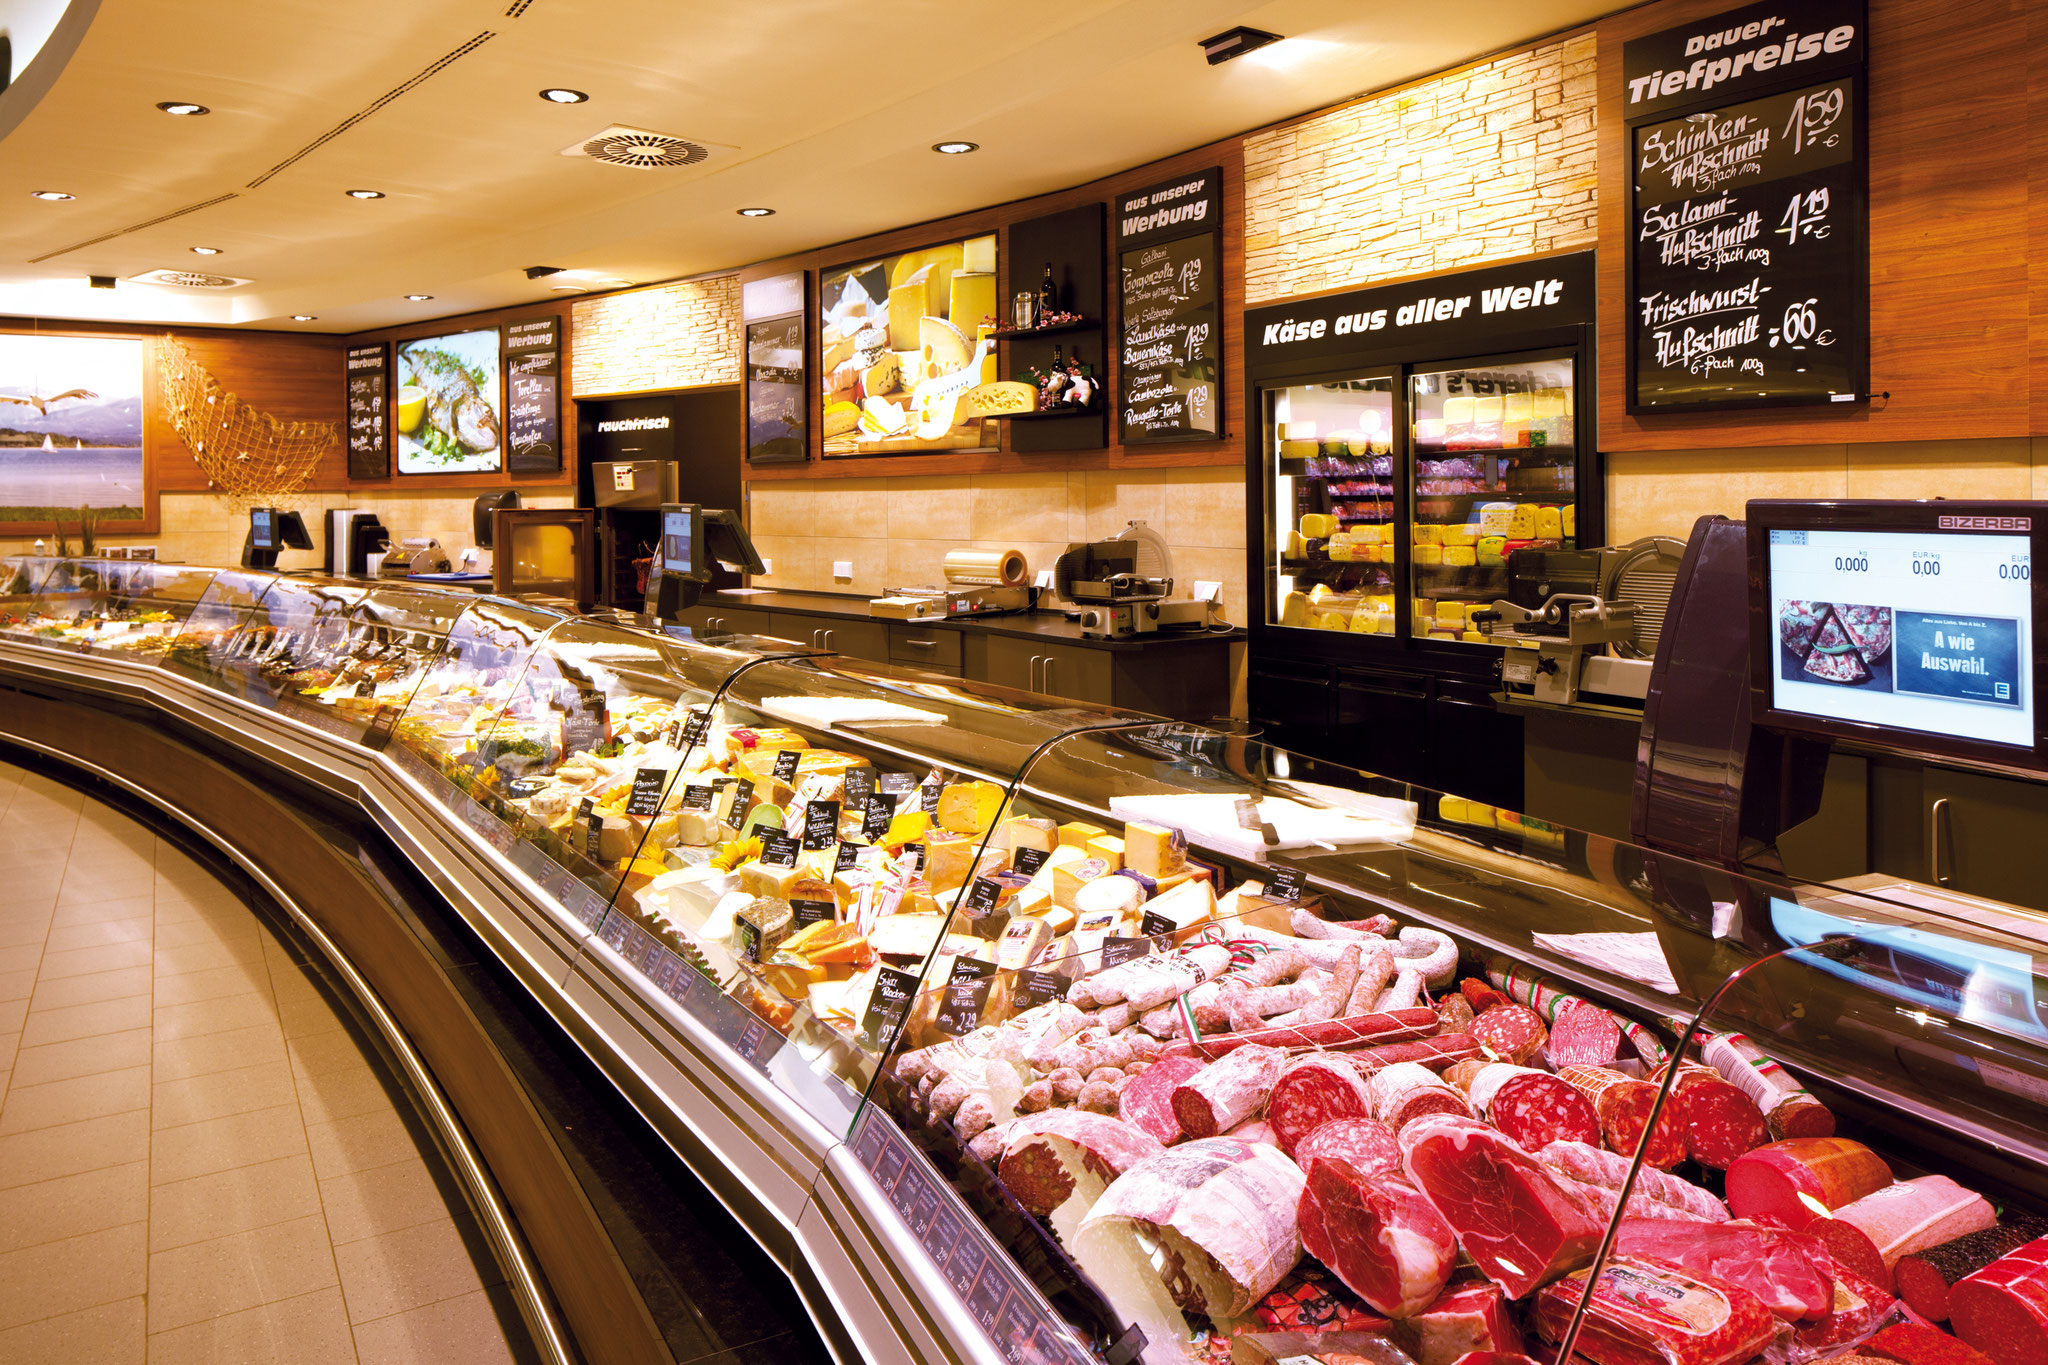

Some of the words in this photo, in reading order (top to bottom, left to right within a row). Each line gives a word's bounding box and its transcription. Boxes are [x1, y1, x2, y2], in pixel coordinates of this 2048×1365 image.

[1685, 16, 1785, 57] Dauer-
[1628, 25, 1855, 104] Tiefpreise
[1641, 115, 1758, 173] Schinken-
[1661, 127, 1770, 188] Aufschnitt
[1125, 196, 1148, 212] aus
[1151, 179, 1205, 204] unserer
[1122, 199, 1208, 236] Werbung
[1640, 189, 1737, 242] Salami-
[1656, 211, 1762, 266] Aufschnitt
[1262, 319, 1326, 346] Käse
[1334, 309, 1387, 336] aus
[1396, 296, 1471, 327] aller
[1481, 278, 1563, 315] Welt
[1639, 277, 1772, 327] Frischwurst-
[510, 325, 522, 333] aus
[523, 321, 551, 331] unserer
[1126, 322, 1176, 345] Landkäse
[508, 332, 552, 348] Werbung
[1653, 314, 1760, 368] Aufschnitt
[348, 357, 382, 370] Werbung
[1124, 341, 1173, 364] Bauernkäse
[1740, 358, 1764, 376] 100g
[598, 416, 670, 432] rauchfrisch
[1940, 517, 2030, 529] BIZERBA
[1835, 557, 1868, 573] 0,000
[1859, 550, 1867, 558] kg
[1912, 551, 1941, 560] EUR/kg
[1912, 560, 1941, 576] 0,00
[1999, 564, 2030, 580] 0,00
[1934, 631, 1944, 649] A
[1949, 632, 1975, 651] wie
[1921, 652, 1990, 676] Auswahl.
[1607, 1268, 1636, 1282] Casa
[1636, 1276, 1680, 1298] Modena
